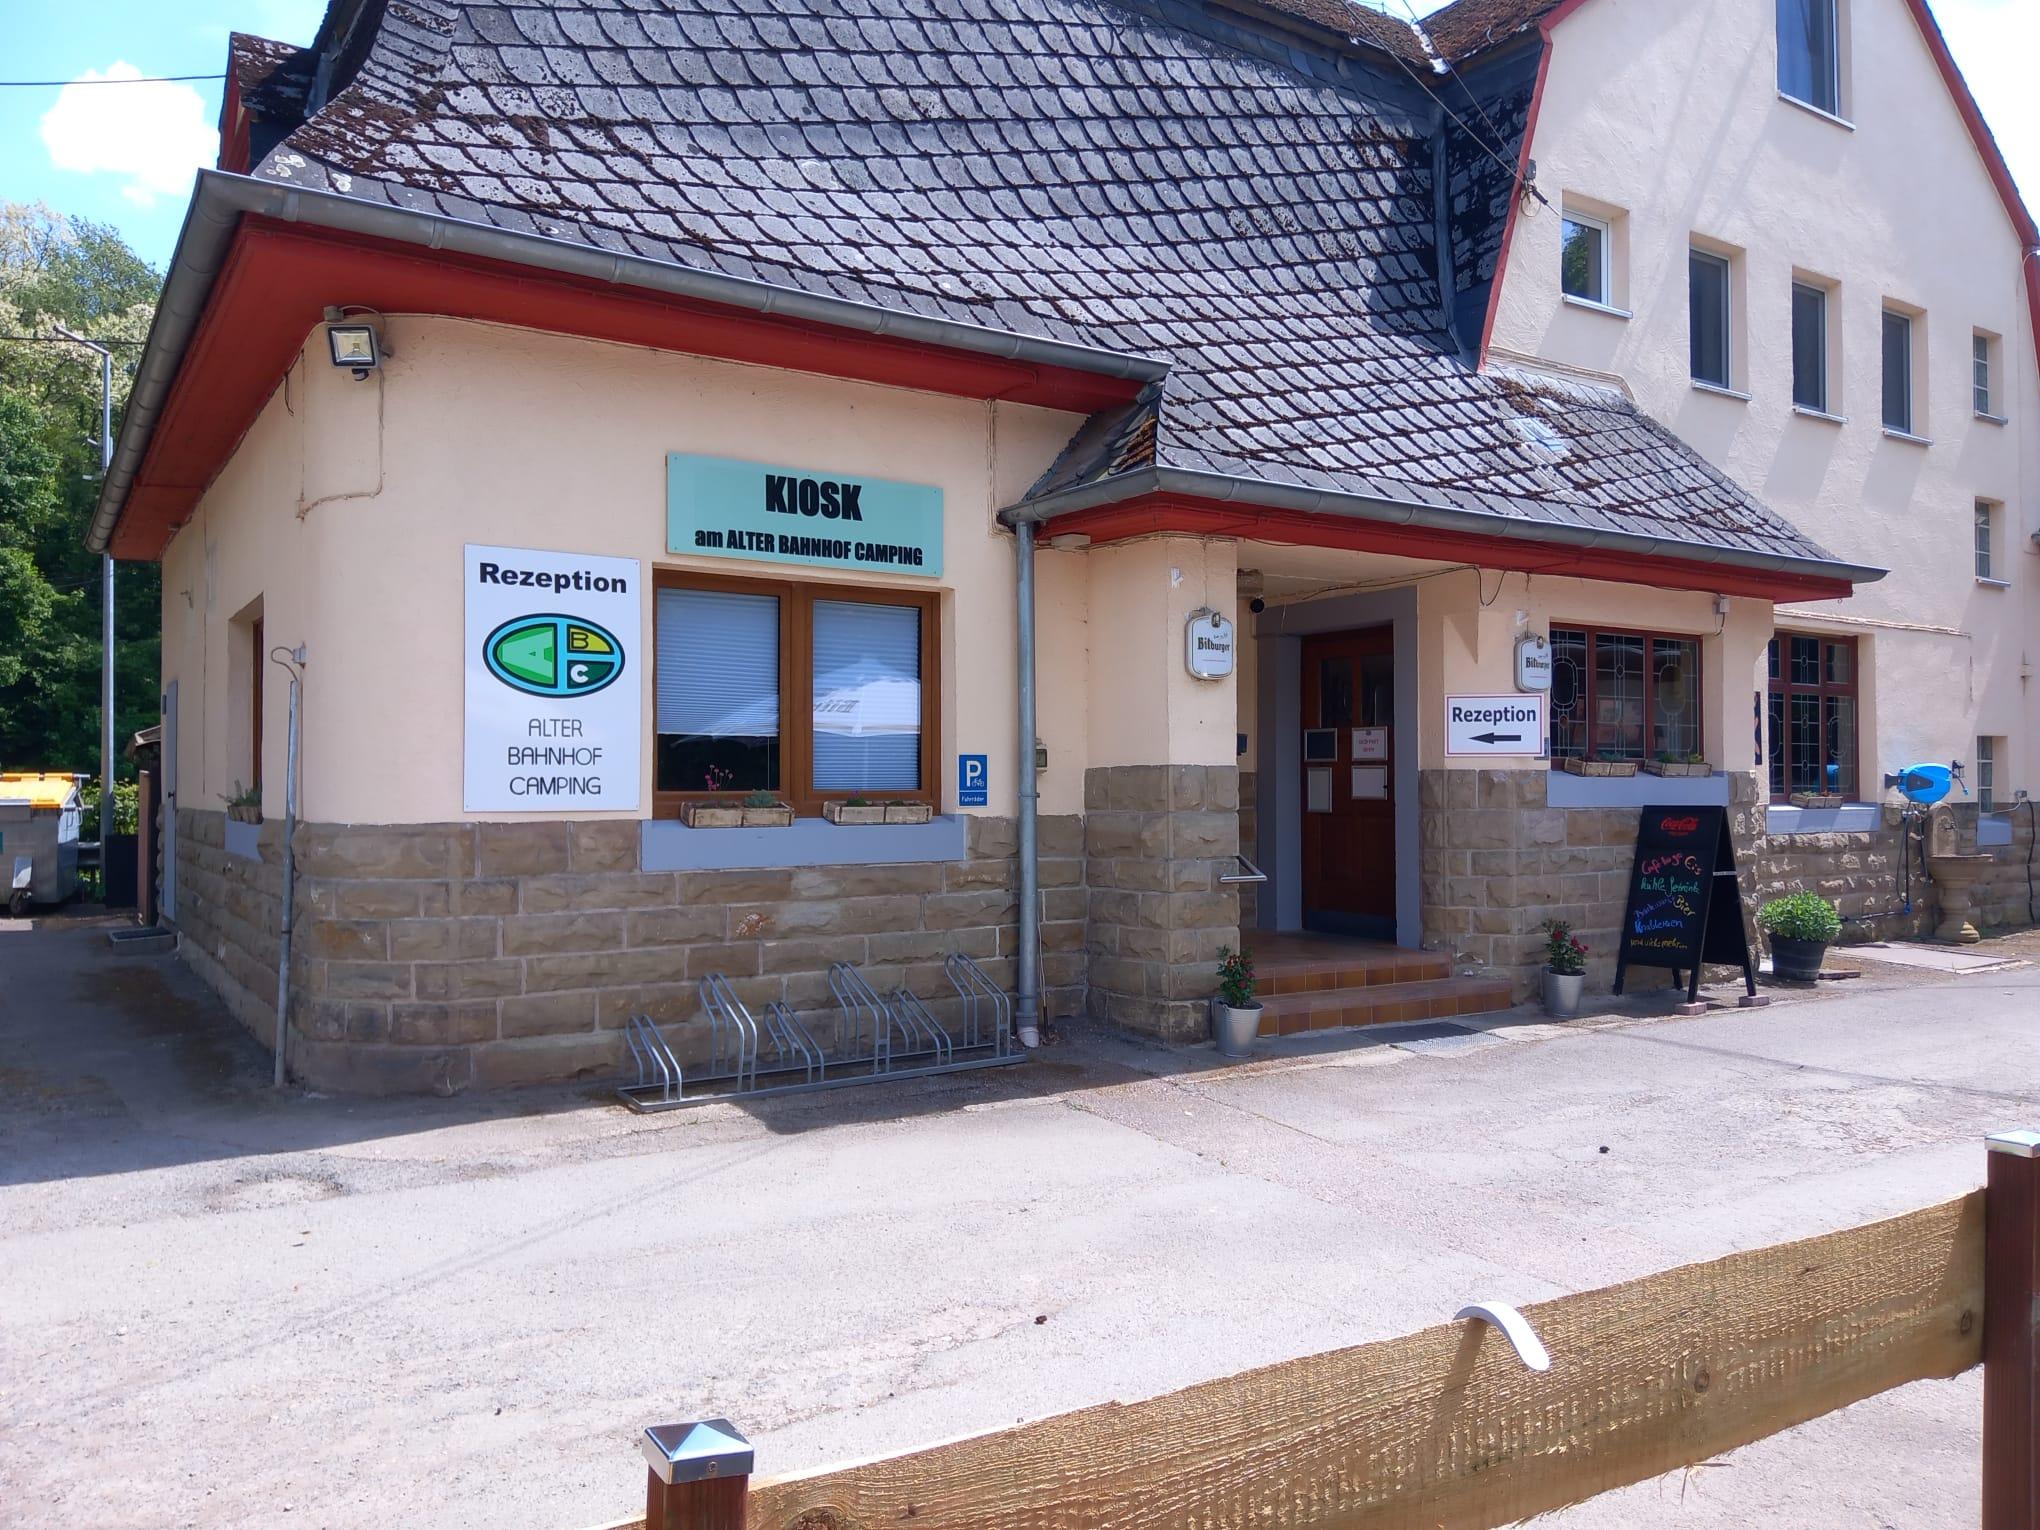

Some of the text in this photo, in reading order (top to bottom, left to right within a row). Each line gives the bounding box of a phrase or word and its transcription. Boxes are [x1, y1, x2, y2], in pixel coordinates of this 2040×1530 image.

[765, 474, 863, 521] KIOSK
[695, 530, 923, 566] am ALTER BAHNHOF CAMPING
[479, 562, 627, 594] Rezeption
[570, 631, 590, 650] B
[1197, 637, 1231, 653] Bitburger
[570, 663, 589, 684] C
[1452, 705, 1537, 726] Rezeption
[528, 718, 583, 738] ALTER
[507, 746, 603, 766] BAHNHOF
[966, 760, 982, 787] P
[509, 776, 602, 796] CAMPING
[1673, 895, 1696, 917] Bier
